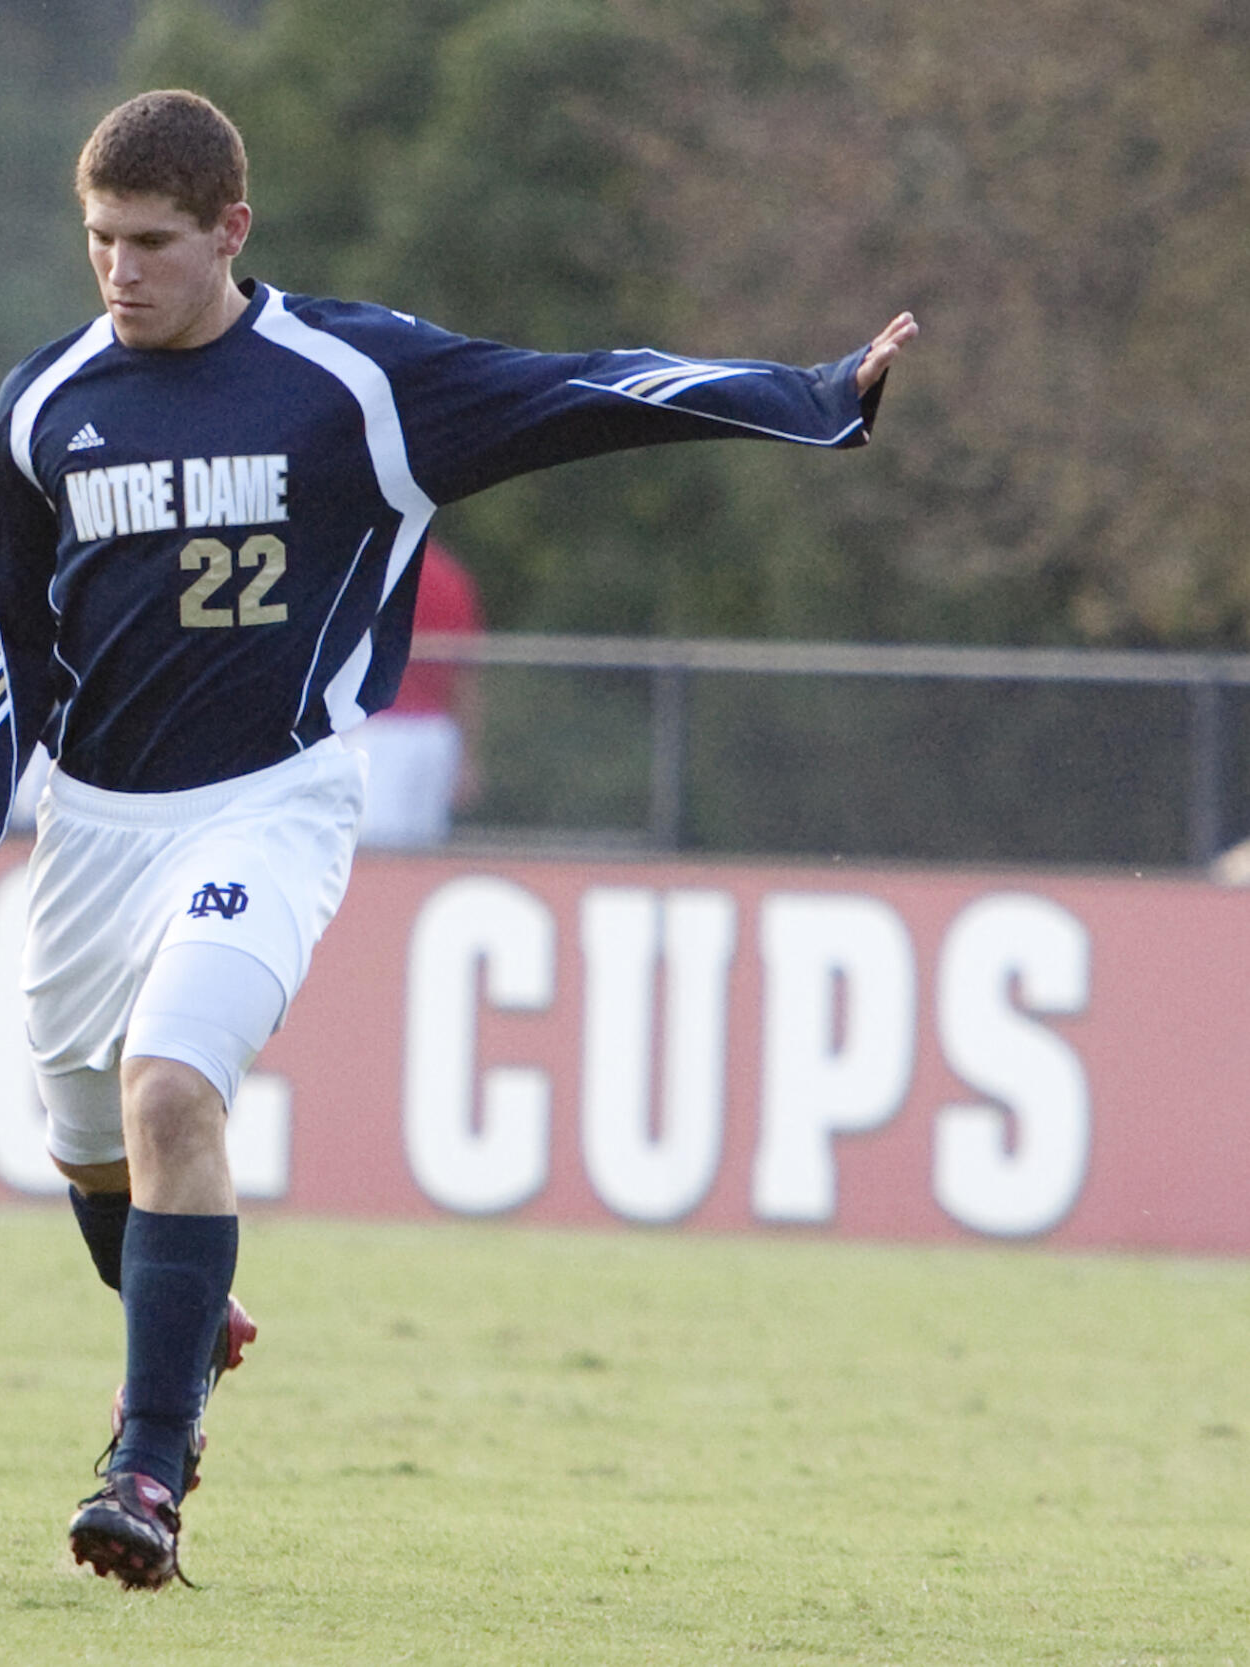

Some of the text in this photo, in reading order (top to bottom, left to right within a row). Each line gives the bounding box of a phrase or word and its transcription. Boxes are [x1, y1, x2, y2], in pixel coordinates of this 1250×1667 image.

[65, 454, 290, 542] NOTRE DAME
[180, 534, 288, 628] 22
[403, 876, 1092, 1235] CUPS
